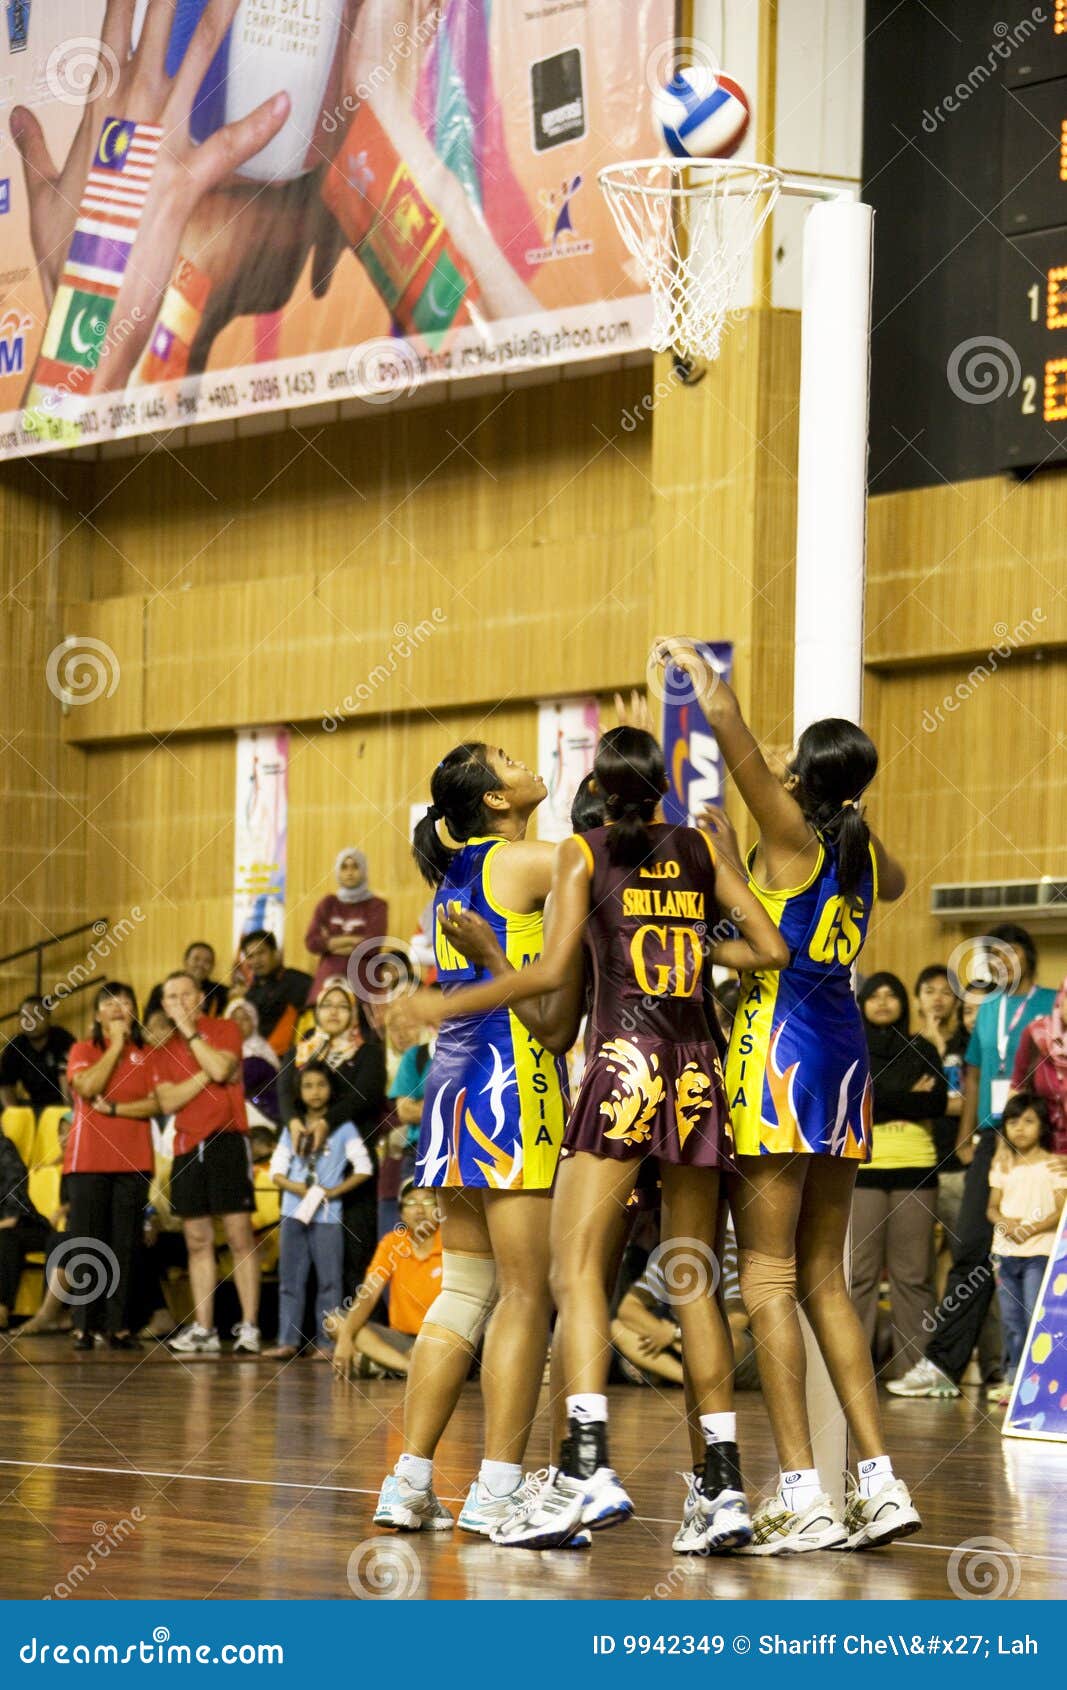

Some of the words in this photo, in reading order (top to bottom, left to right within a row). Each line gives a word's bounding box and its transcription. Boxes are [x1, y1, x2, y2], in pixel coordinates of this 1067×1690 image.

[1027, 284, 1039, 322] 1
[1022, 376, 1036, 414] 2
[623, 888, 652, 916] SRI
[653, 890, 704, 920] LANKA
[809, 895, 864, 966] GS
[630, 924, 703, 997] GD
